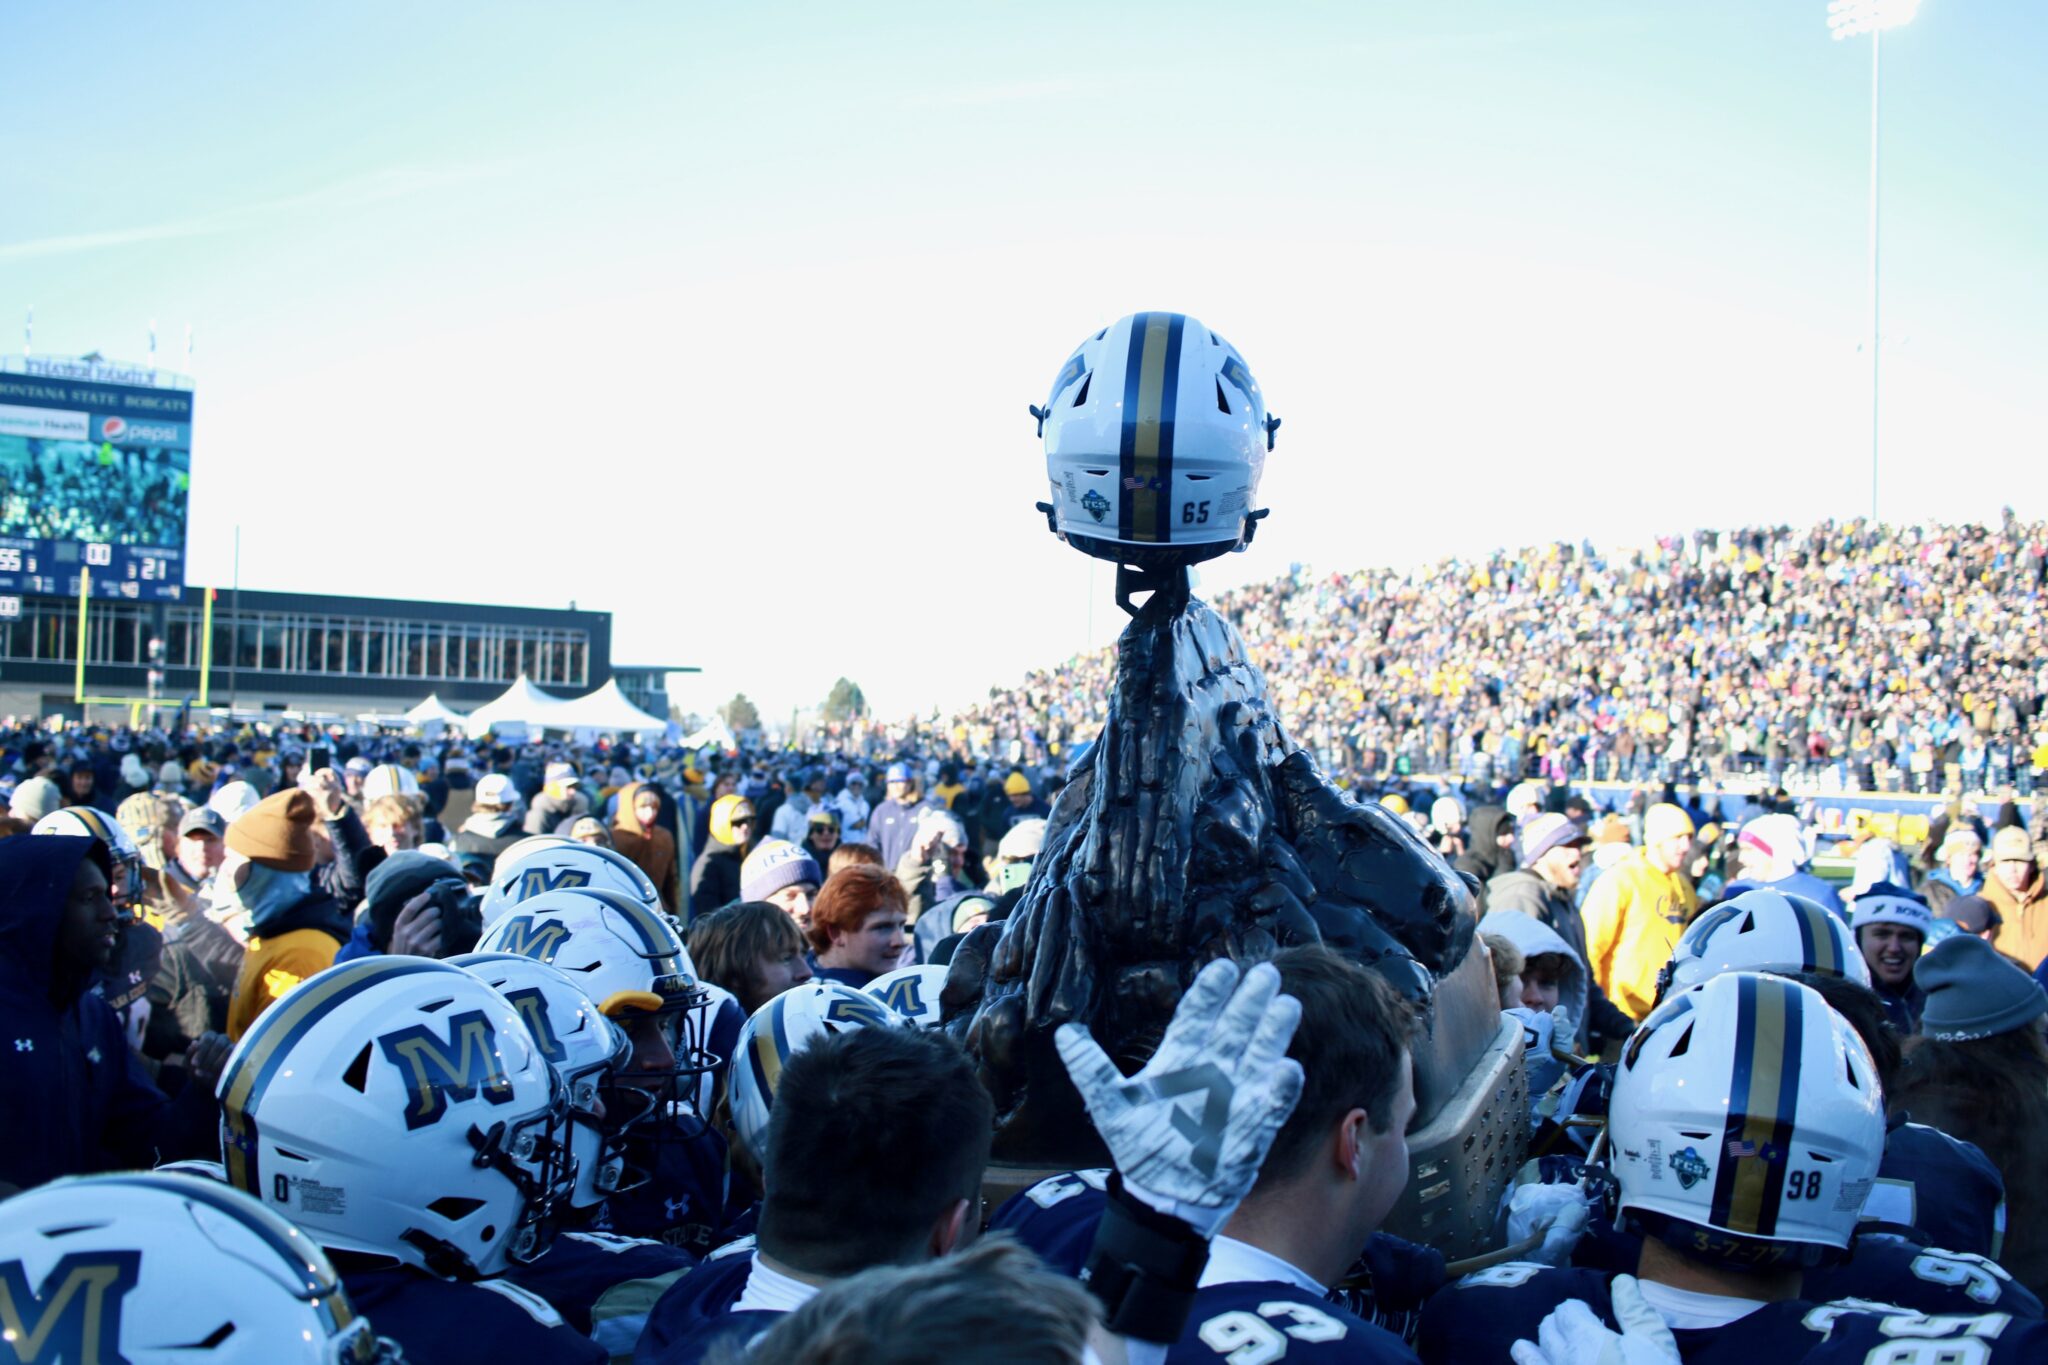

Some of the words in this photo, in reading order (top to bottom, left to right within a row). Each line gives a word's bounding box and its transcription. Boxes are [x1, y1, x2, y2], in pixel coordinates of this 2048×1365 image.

[71, 388, 118, 407] STATE
[124, 394, 188, 412] BOBCATS
[129, 424, 178, 442] pepsi
[1183, 501, 1211, 523] 65
[141, 557, 166, 580] 21
[377, 1009, 515, 1131] M
[274, 1173, 289, 1203] 0
[1787, 1171, 1822, 1200] 98
[662, 1223, 714, 1247] STATE
[1694, 1231, 1788, 1265] 3-7-77
